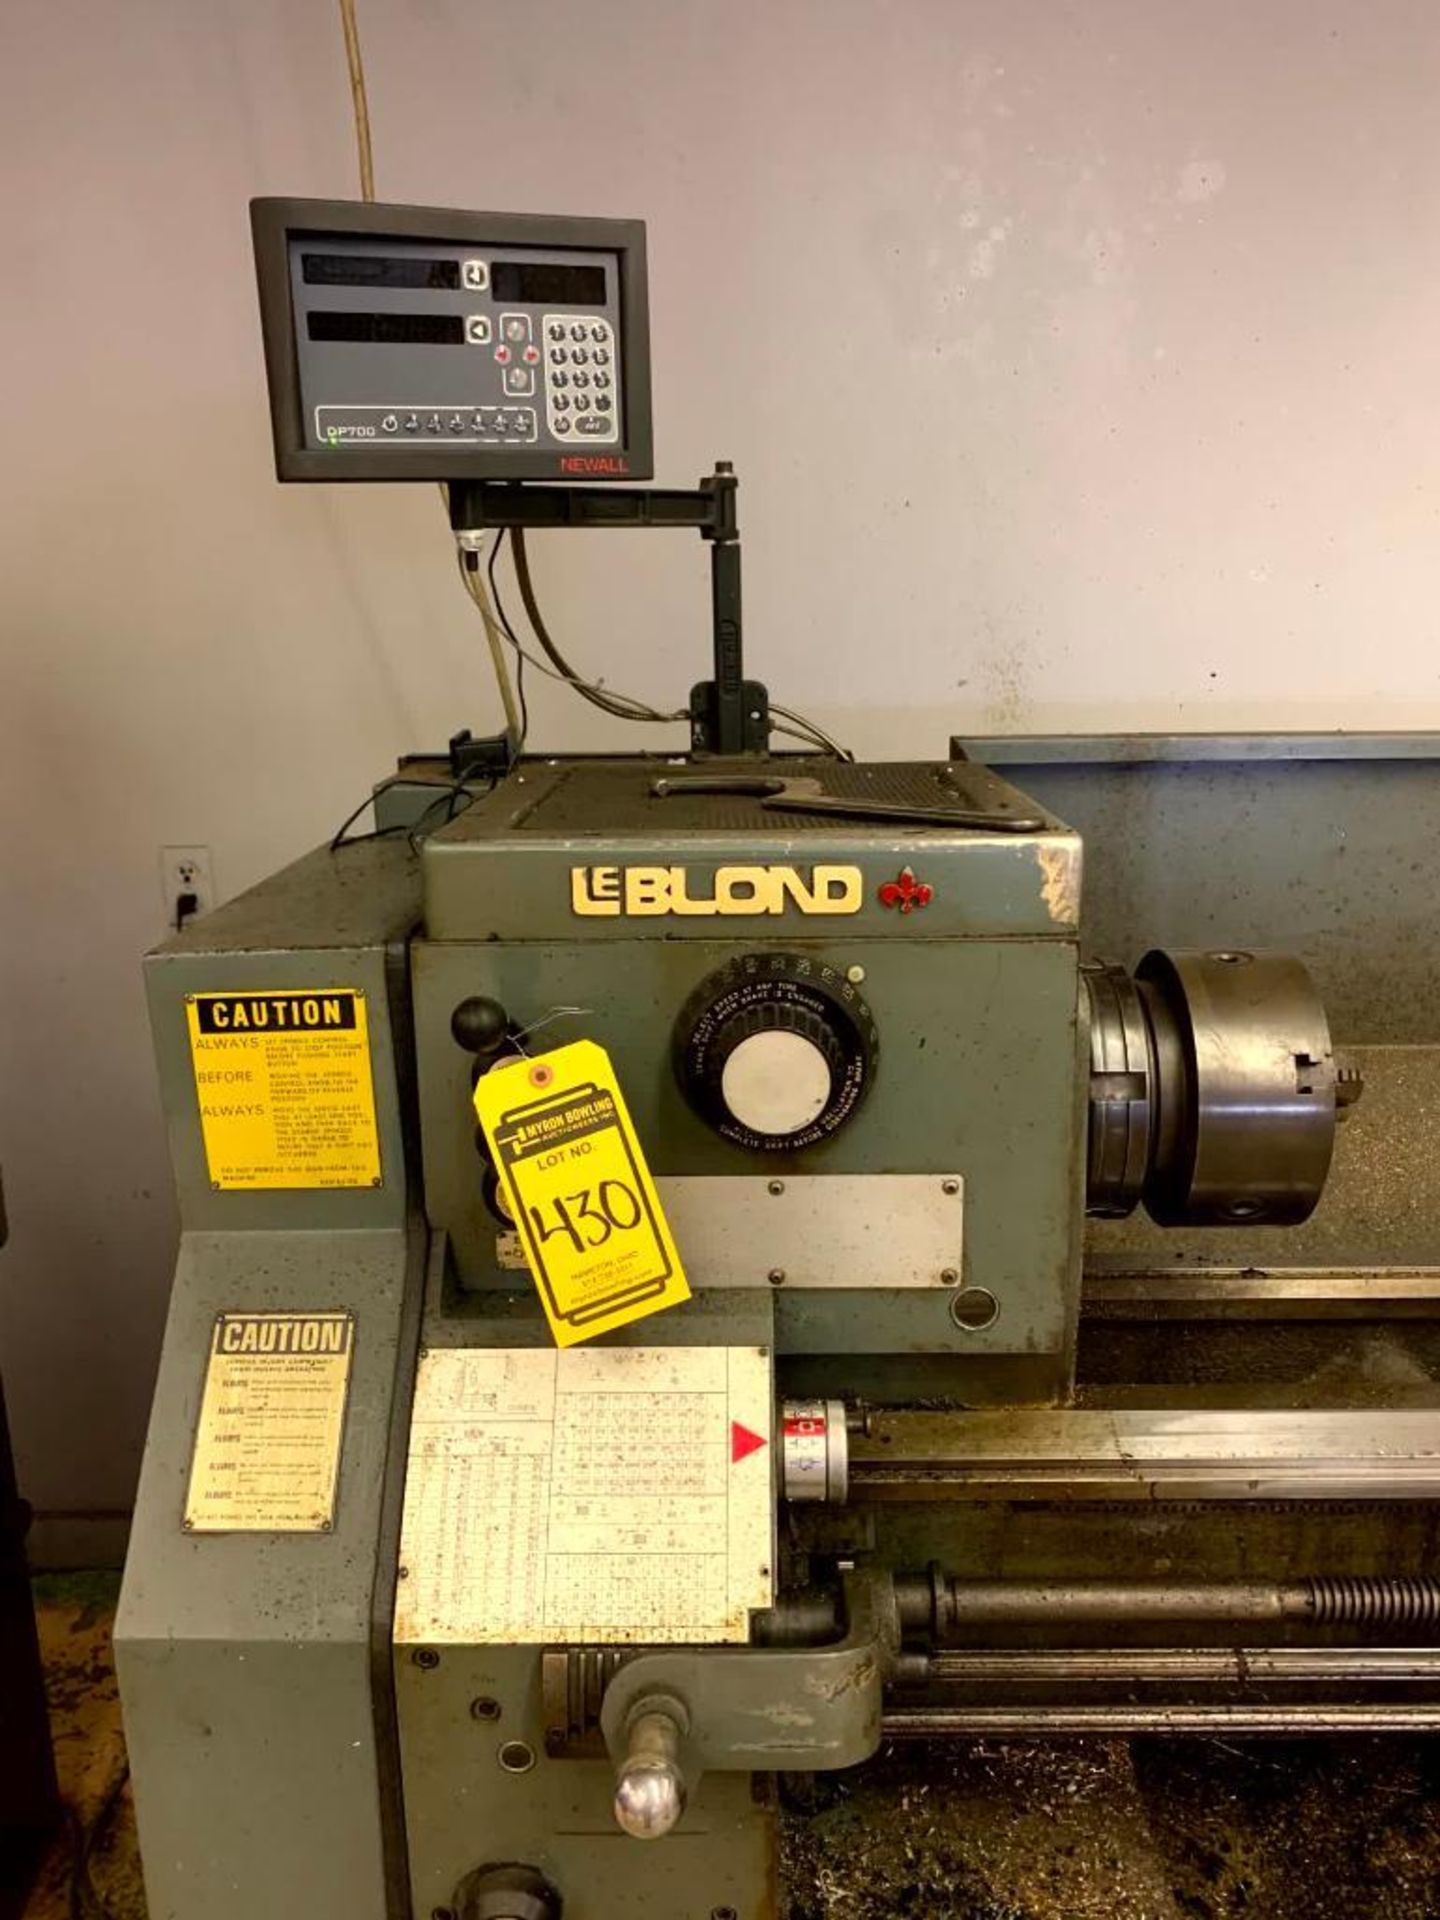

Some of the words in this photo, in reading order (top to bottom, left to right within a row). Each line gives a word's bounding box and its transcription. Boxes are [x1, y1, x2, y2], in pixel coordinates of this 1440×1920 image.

[561, 457, 630, 473] NEWALL
[212, 999, 342, 1028] CAUTION
[195, 1037, 260, 1050] ALWAYS
[197, 1070, 253, 1084] BEFORE
[202, 1104, 265, 1117] ALWAYS
[525, 1115, 565, 1138] MYRON
[564, 1097, 613, 1124] BOWLING
[537, 1151, 565, 1171] LOT
[529, 1180, 642, 1254] 430
[222, 1321, 343, 1352] CAUTION
